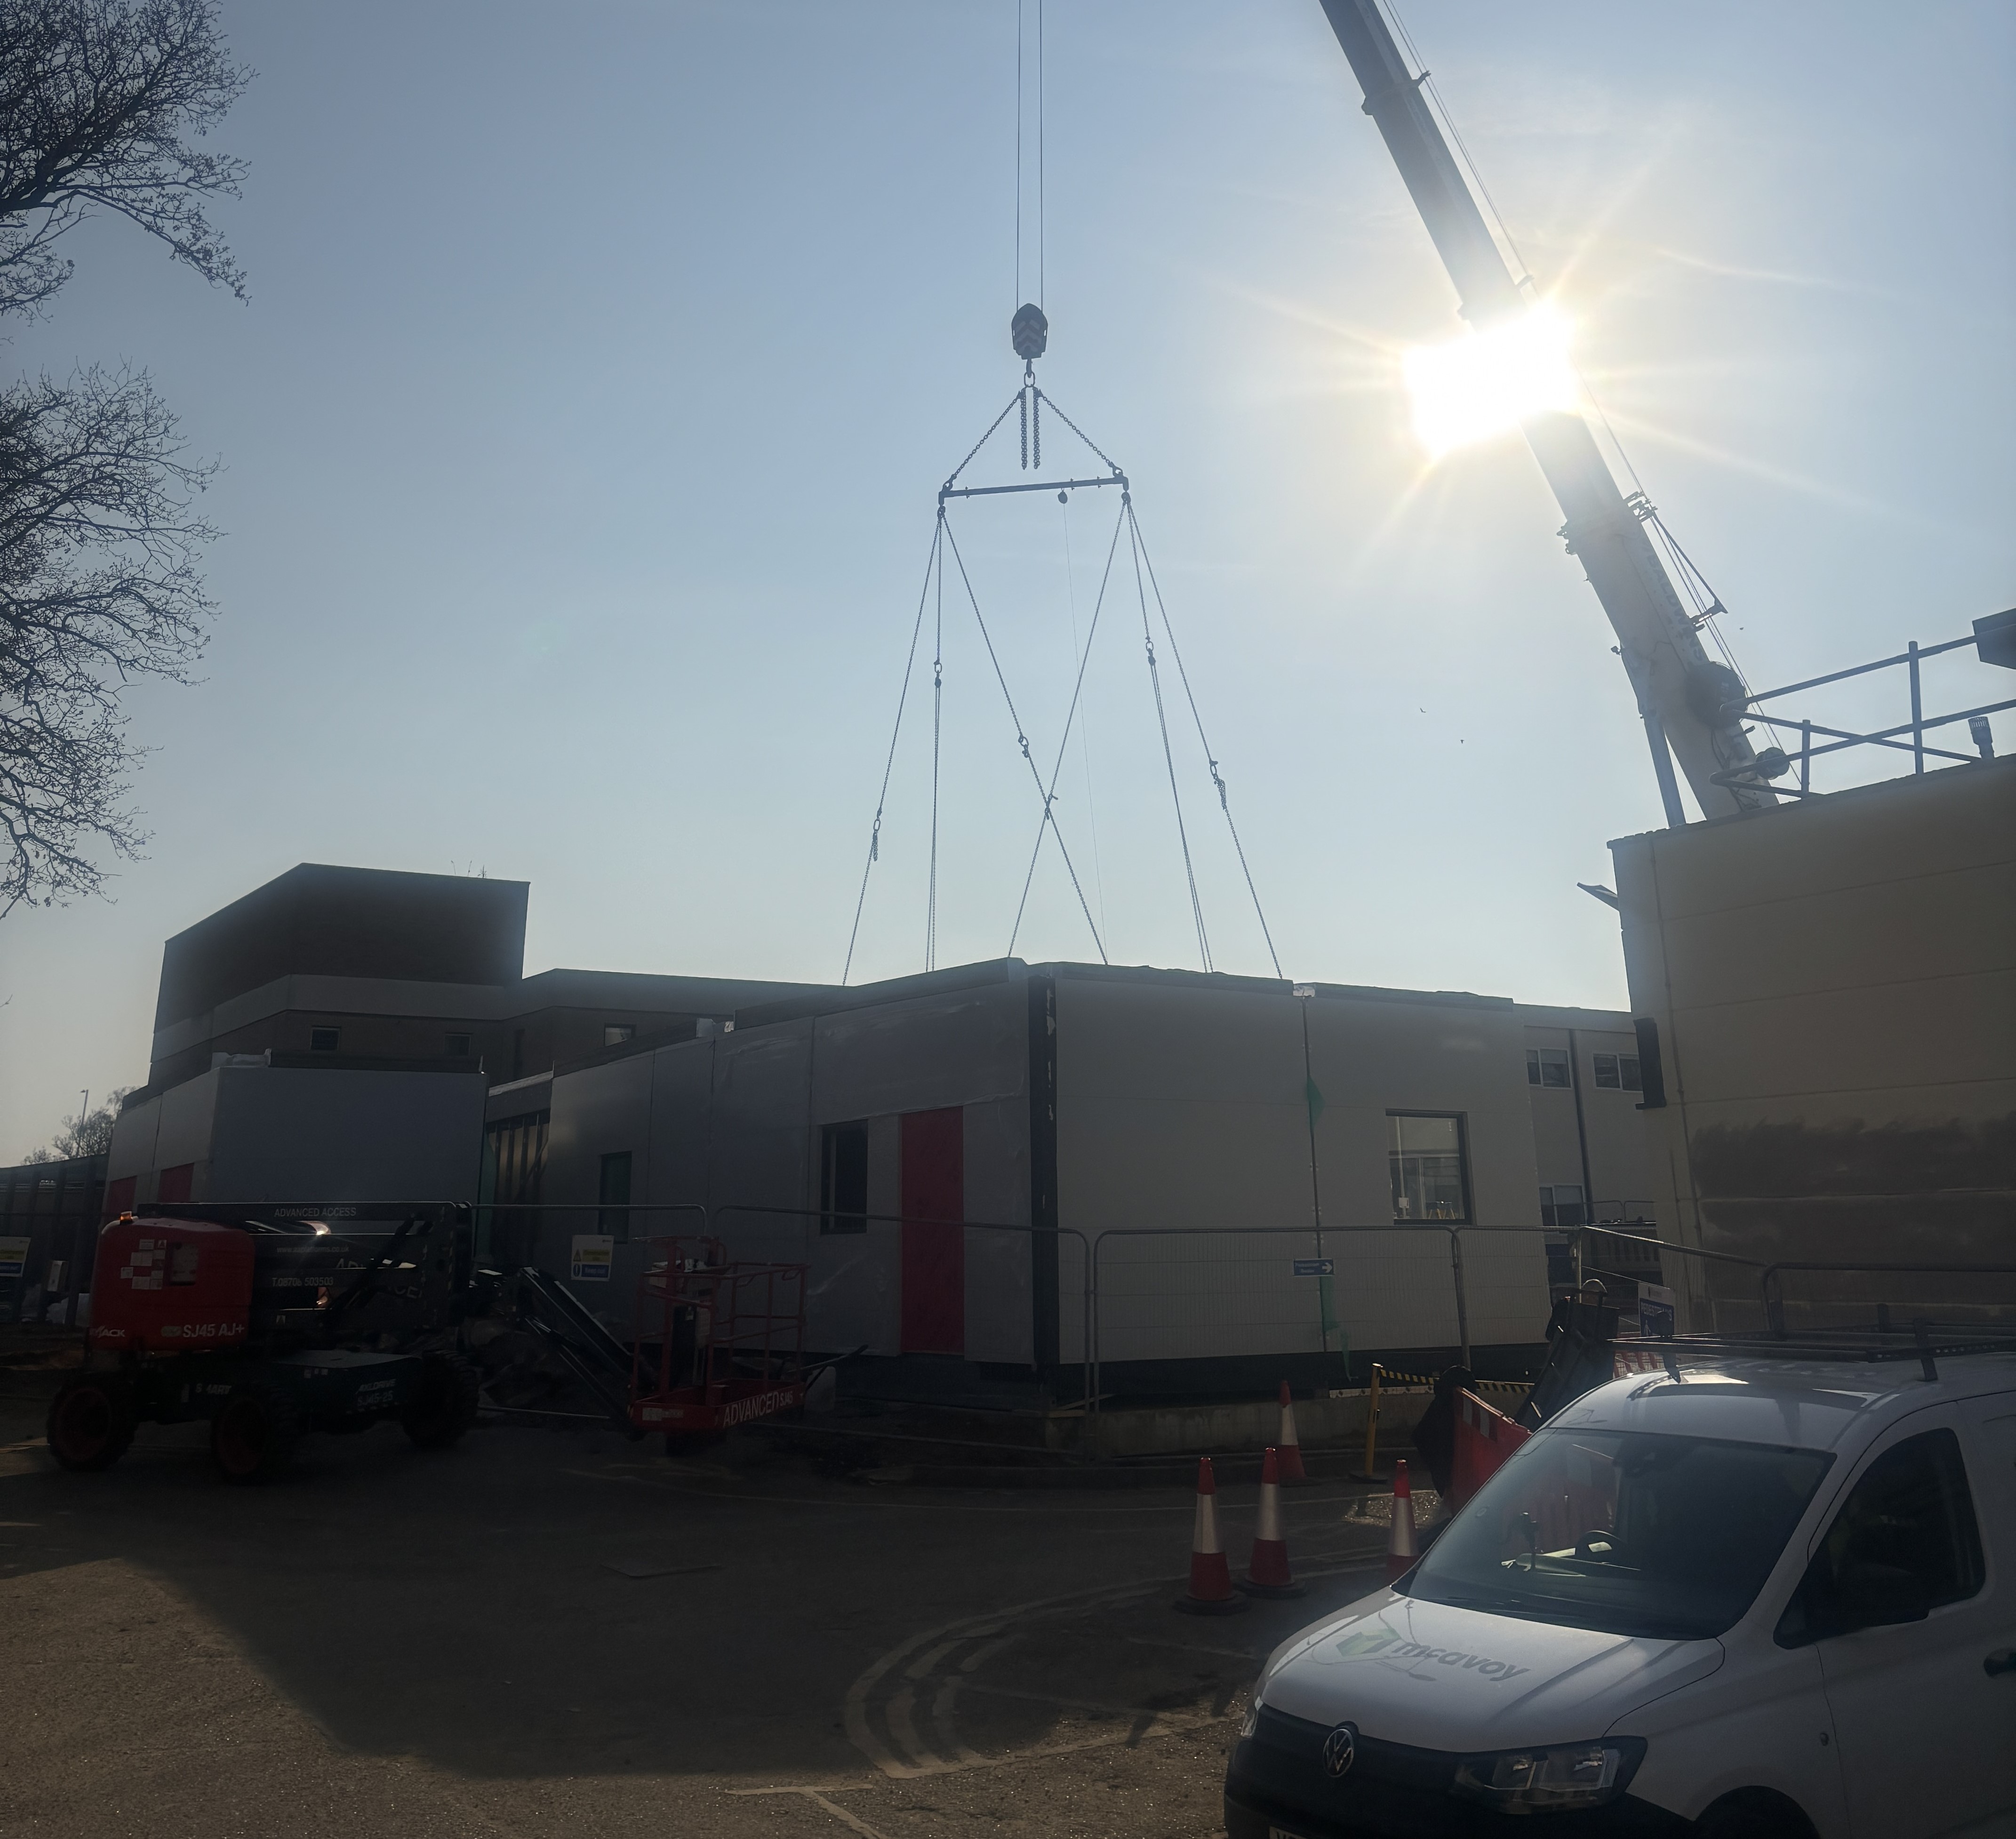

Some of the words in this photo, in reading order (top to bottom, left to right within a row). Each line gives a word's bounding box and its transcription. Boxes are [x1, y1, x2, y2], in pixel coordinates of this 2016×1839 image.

[274, 1208, 320, 1217] ADVANCED
[322, 1207, 356, 1216] ACCESS
[183, 1324, 216, 1337] SJ45
[1392, 1642, 1531, 1682] mcavoy
